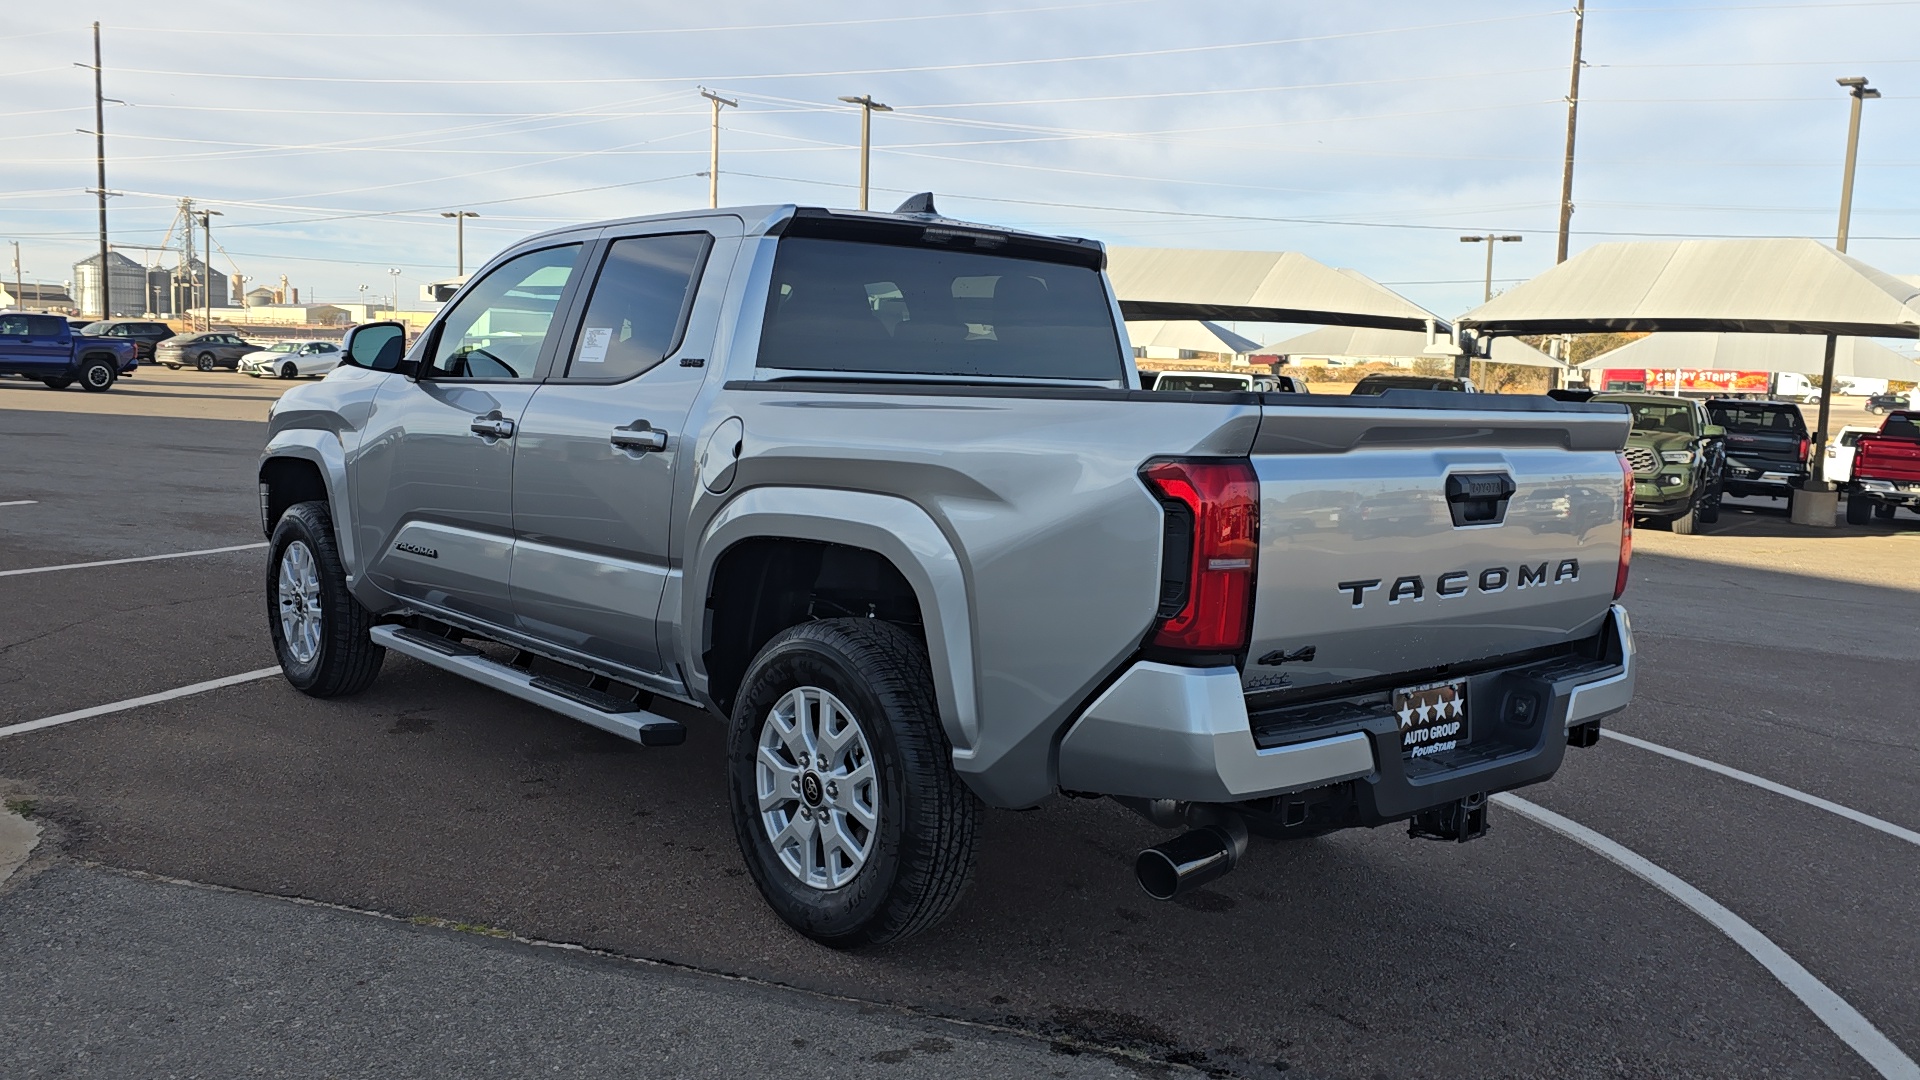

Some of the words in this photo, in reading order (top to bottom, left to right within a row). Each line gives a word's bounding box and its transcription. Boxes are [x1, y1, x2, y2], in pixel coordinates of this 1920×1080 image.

[1472, 482, 1500, 494] TOYOTA
[394, 541, 439, 559] TACOMA
[1338, 558, 1580, 609] TACOMA
[1404, 728, 1429, 746] AUTO
[1430, 721, 1460, 740] GROUP
